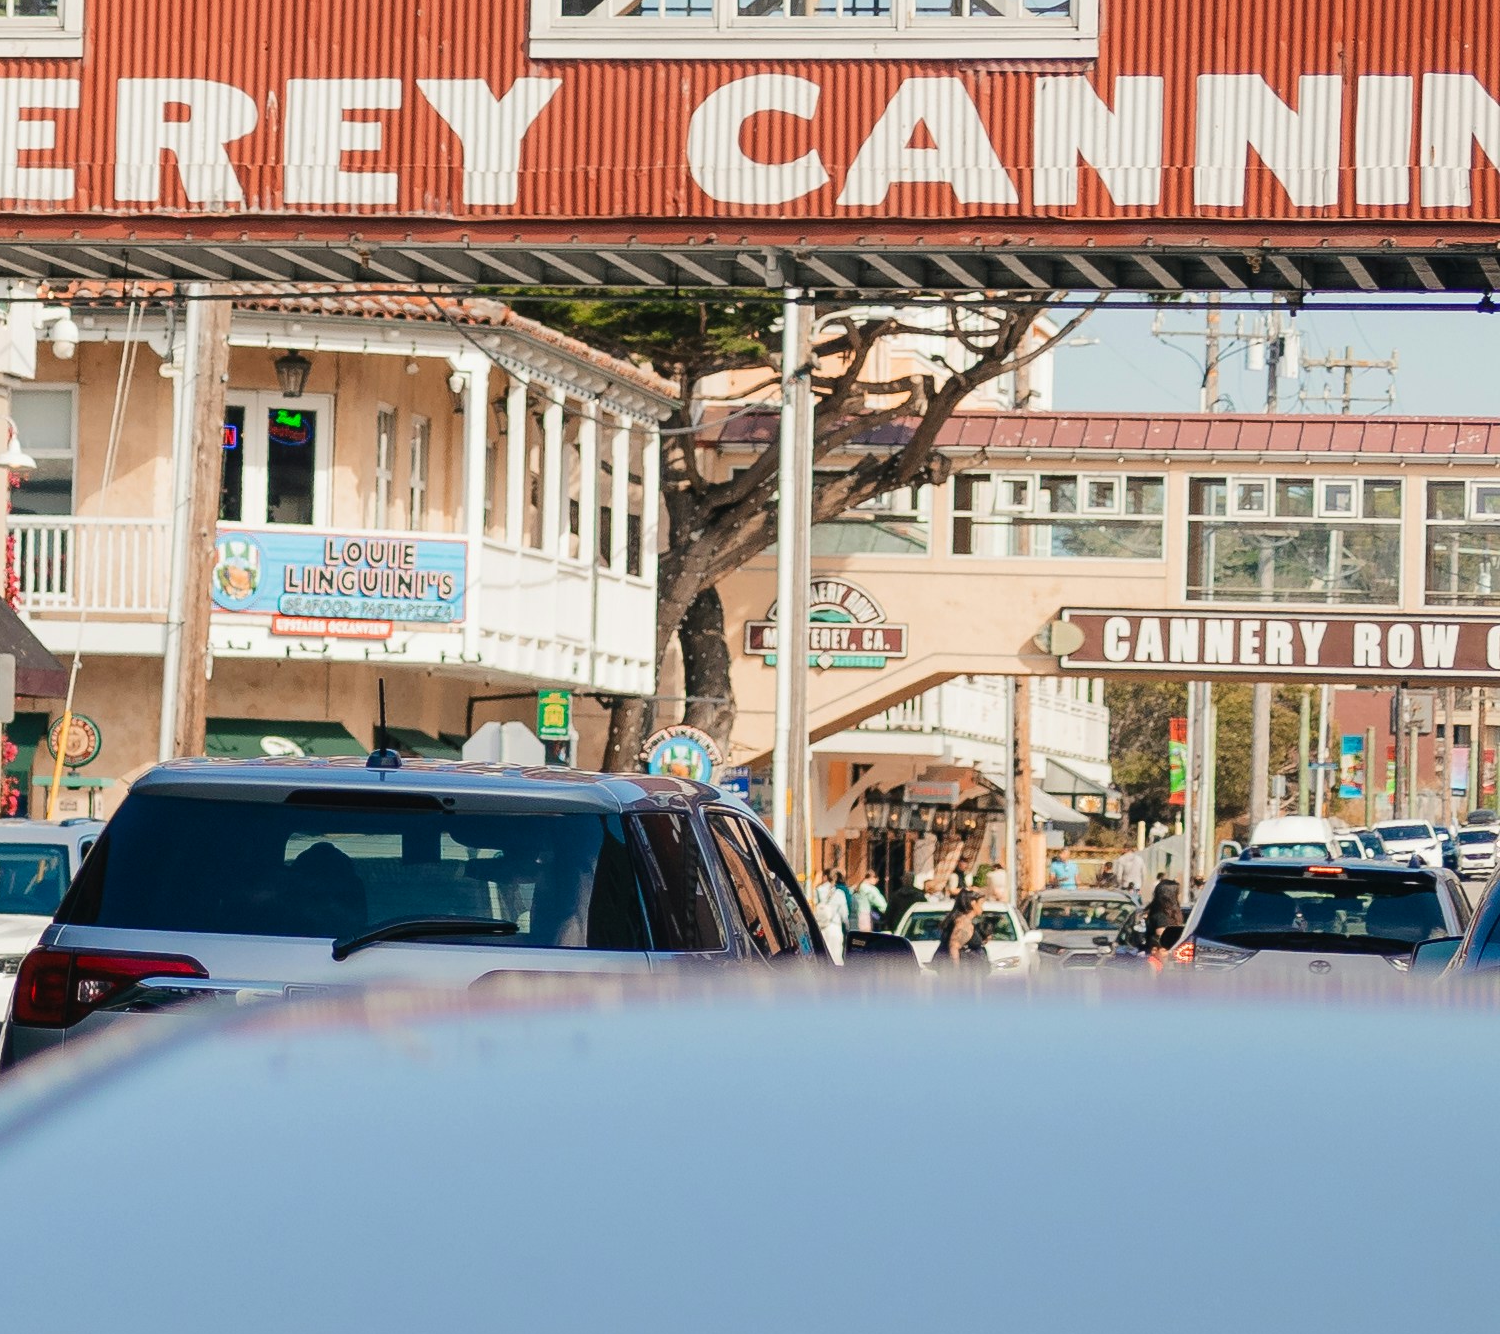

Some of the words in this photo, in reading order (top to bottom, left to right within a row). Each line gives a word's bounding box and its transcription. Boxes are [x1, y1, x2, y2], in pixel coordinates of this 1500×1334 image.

[686, 73, 1500, 208] CANNIN
[323, 537, 417, 569] LOUIE
[284, 564, 454, 599] LINGUINI'S
[1103, 616, 1327, 666] CANNERY
[1353, 622, 1460, 669] ROW
